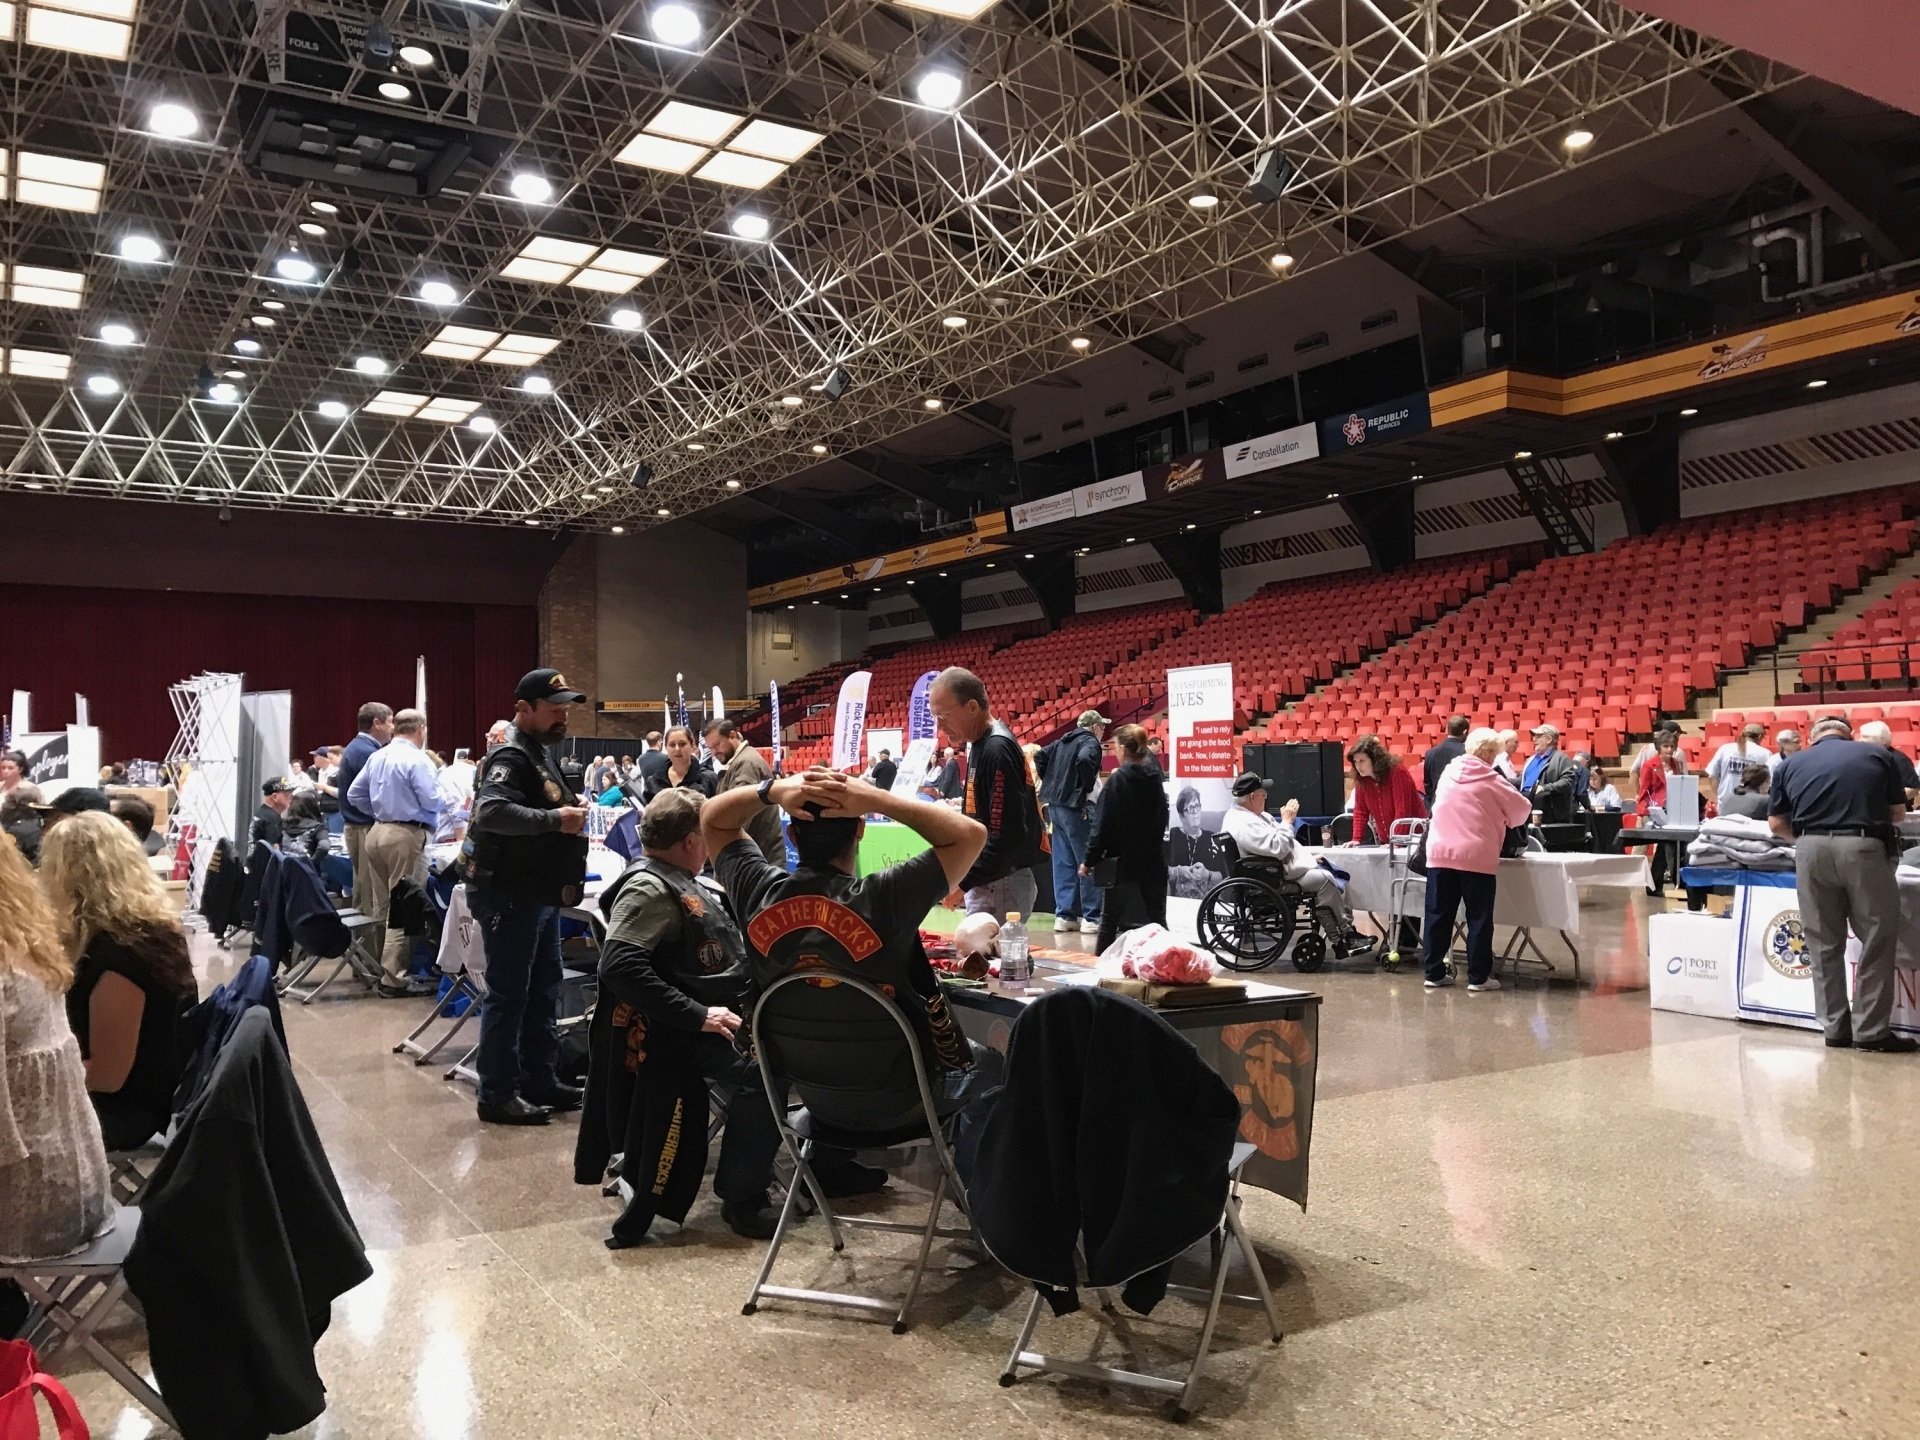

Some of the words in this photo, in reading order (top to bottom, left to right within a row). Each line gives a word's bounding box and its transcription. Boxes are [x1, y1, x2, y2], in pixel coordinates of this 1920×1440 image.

[289, 37, 319, 51] FOULS
[1703, 353, 1766, 380] CHARGE
[1368, 409, 1409, 428] REPUBLIC
[1377, 421, 1401, 431] SERVICES
[1252, 441, 1300, 461] Constellation
[1095, 484, 1131, 501] synchrony
[1274, 540, 1285, 556] 4
[1171, 691, 1204, 707] LIVES
[853, 702, 864, 721] Rick
[913, 696, 924, 729] ISSUED
[1213, 726, 1219, 734] to
[1220, 726, 1231, 735] rely
[849, 723, 861, 763] Campbell
[1187, 740, 1201, 749] going
[1202, 739, 1208, 747] to
[1208, 739, 1217, 747] the
[1217, 738, 1231, 746] food
[1180, 751, 1194, 759] bank.
[1211, 751, 1231, 759] donate
[1184, 764, 1190, 772] to
[1190, 764, 1200, 772] the
[1200, 764, 1212, 772] food
[752, 900, 875, 953] LEATHERNECKS
[1690, 958, 1718, 970] PORT
[1769, 954, 1796, 975] HONOR
[1688, 973, 1719, 982] COMPANY
